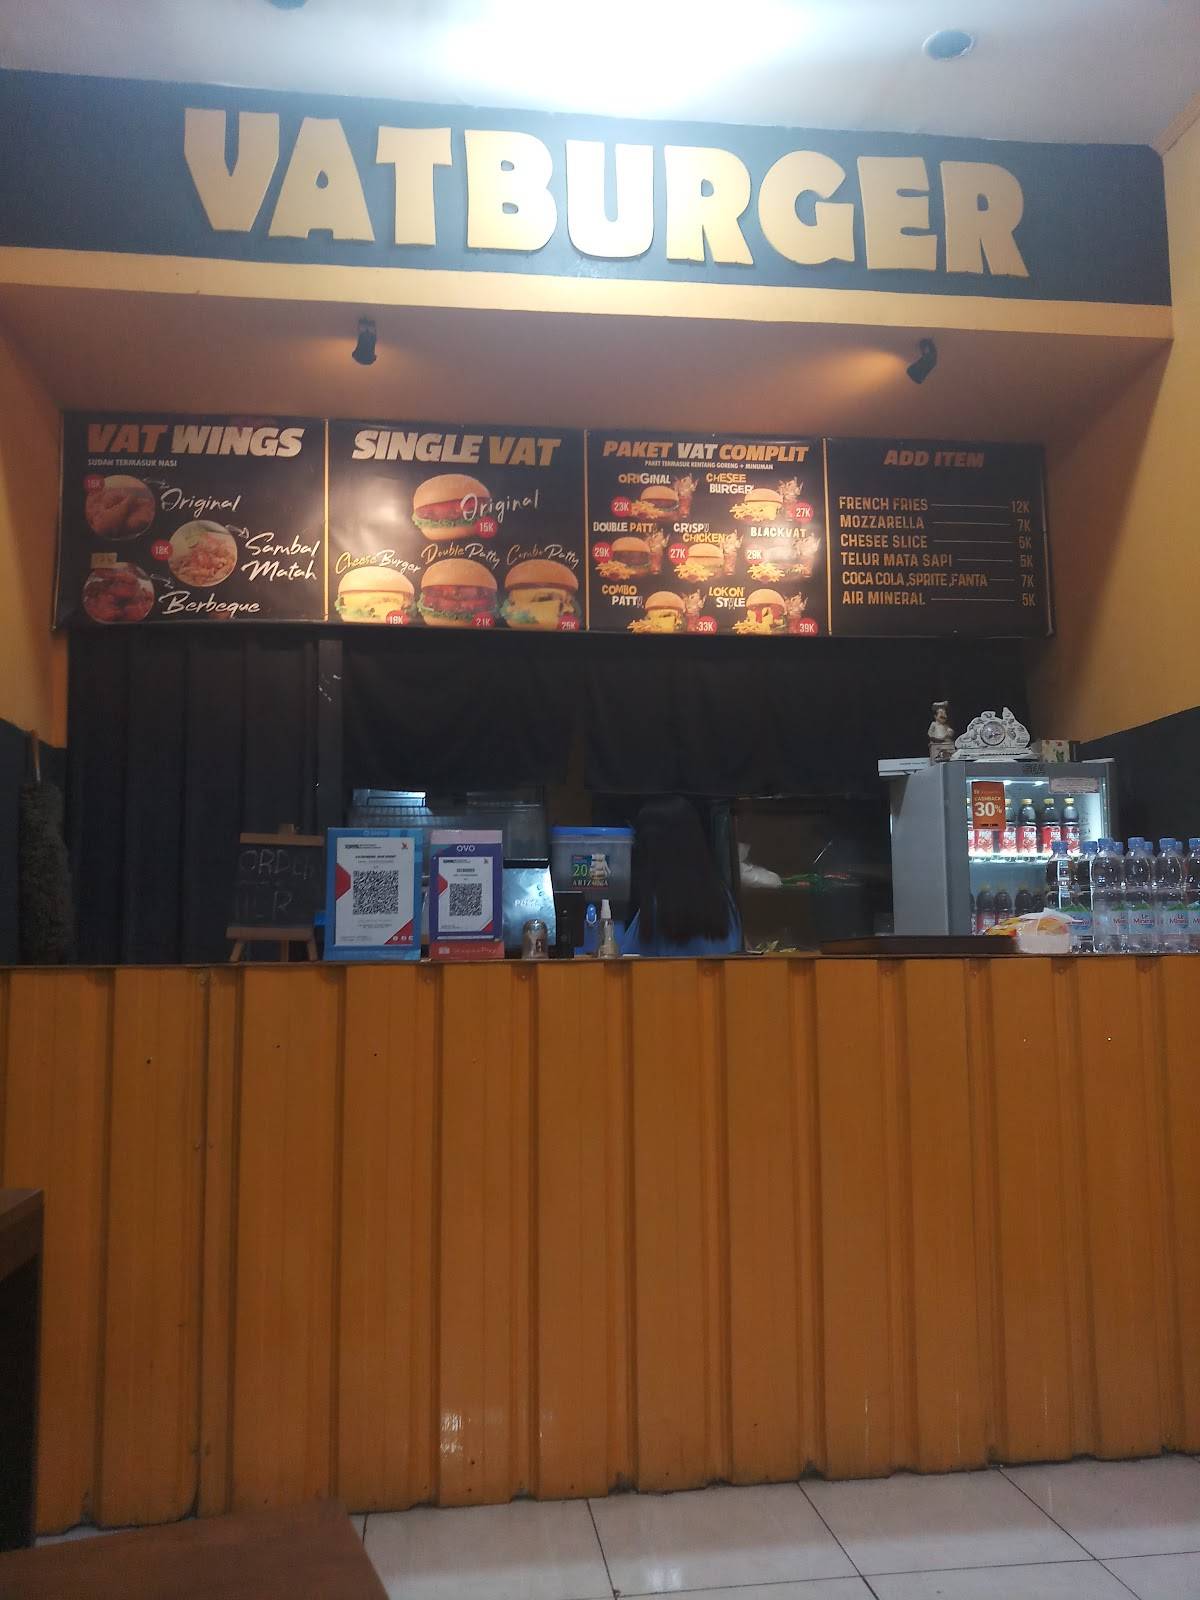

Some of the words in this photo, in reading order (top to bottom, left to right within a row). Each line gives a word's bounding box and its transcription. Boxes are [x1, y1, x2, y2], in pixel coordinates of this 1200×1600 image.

[183, 107, 1030, 278] VATBURGER
[87, 424, 168, 453] VAT
[171, 425, 305, 457] WINGS
[352, 430, 484, 464] SINGLE
[488, 437, 562, 466] VAT
[602, 440, 673, 458] PAKET
[677, 442, 718, 459] VAT
[719, 444, 809, 463] COMPLIT
[158, 459, 177, 467] NASI
[883, 450, 929, 466] ADD
[934, 451, 985, 468] ITEM
[618, 473, 671, 485] ORIGINAL
[706, 473, 747, 483] CHESEE
[709, 484, 753, 494] BURGER
[160, 487, 242, 518] Original
[460, 489, 539, 523] Original
[614, 502, 629, 512] 23K
[839, 496, 889, 511] FRENCH
[893, 497, 928, 511] FRIES
[1011, 500, 1030, 513] 12K
[796, 507, 811, 518] 27K
[593, 522, 628, 532] DOUBLE
[840, 514, 925, 529] MOZZARELLA
[1017, 518, 1031, 532] 7K
[682, 533, 726, 544] CHICKEN
[750, 527, 785, 537] BLACK
[785, 528, 807, 537] VAT
[245, 532, 320, 558] Sambal
[840, 533, 889, 548] CHESEE
[892, 535, 928, 548] SLICE
[420, 542, 464, 565] Double
[464, 542, 501, 569] Patty
[543, 544, 580, 570] Patty
[670, 549, 686, 559] 27K
[840, 551, 880, 566] TELUR
[883, 553, 919, 567] MATA
[922, 553, 952, 567] SAPI
[375, 549, 421, 576] Burger
[241, 560, 317, 581] Matah
[842, 571, 873, 585] COCA
[1020, 574, 1034, 588] 7K
[602, 584, 637, 596] COMBO
[708, 587, 744, 597] LOKON
[158, 590, 261, 615] Berbeque
[716, 597, 746, 610] STYLE
[842, 591, 864, 605] AIR
[867, 592, 926, 605] MINERAL
[1022, 592, 1036, 606] 5K
[476, 617, 491, 628] 21K
[799, 623, 815, 633] 39K
[974, 801, 1002, 817] 30%
